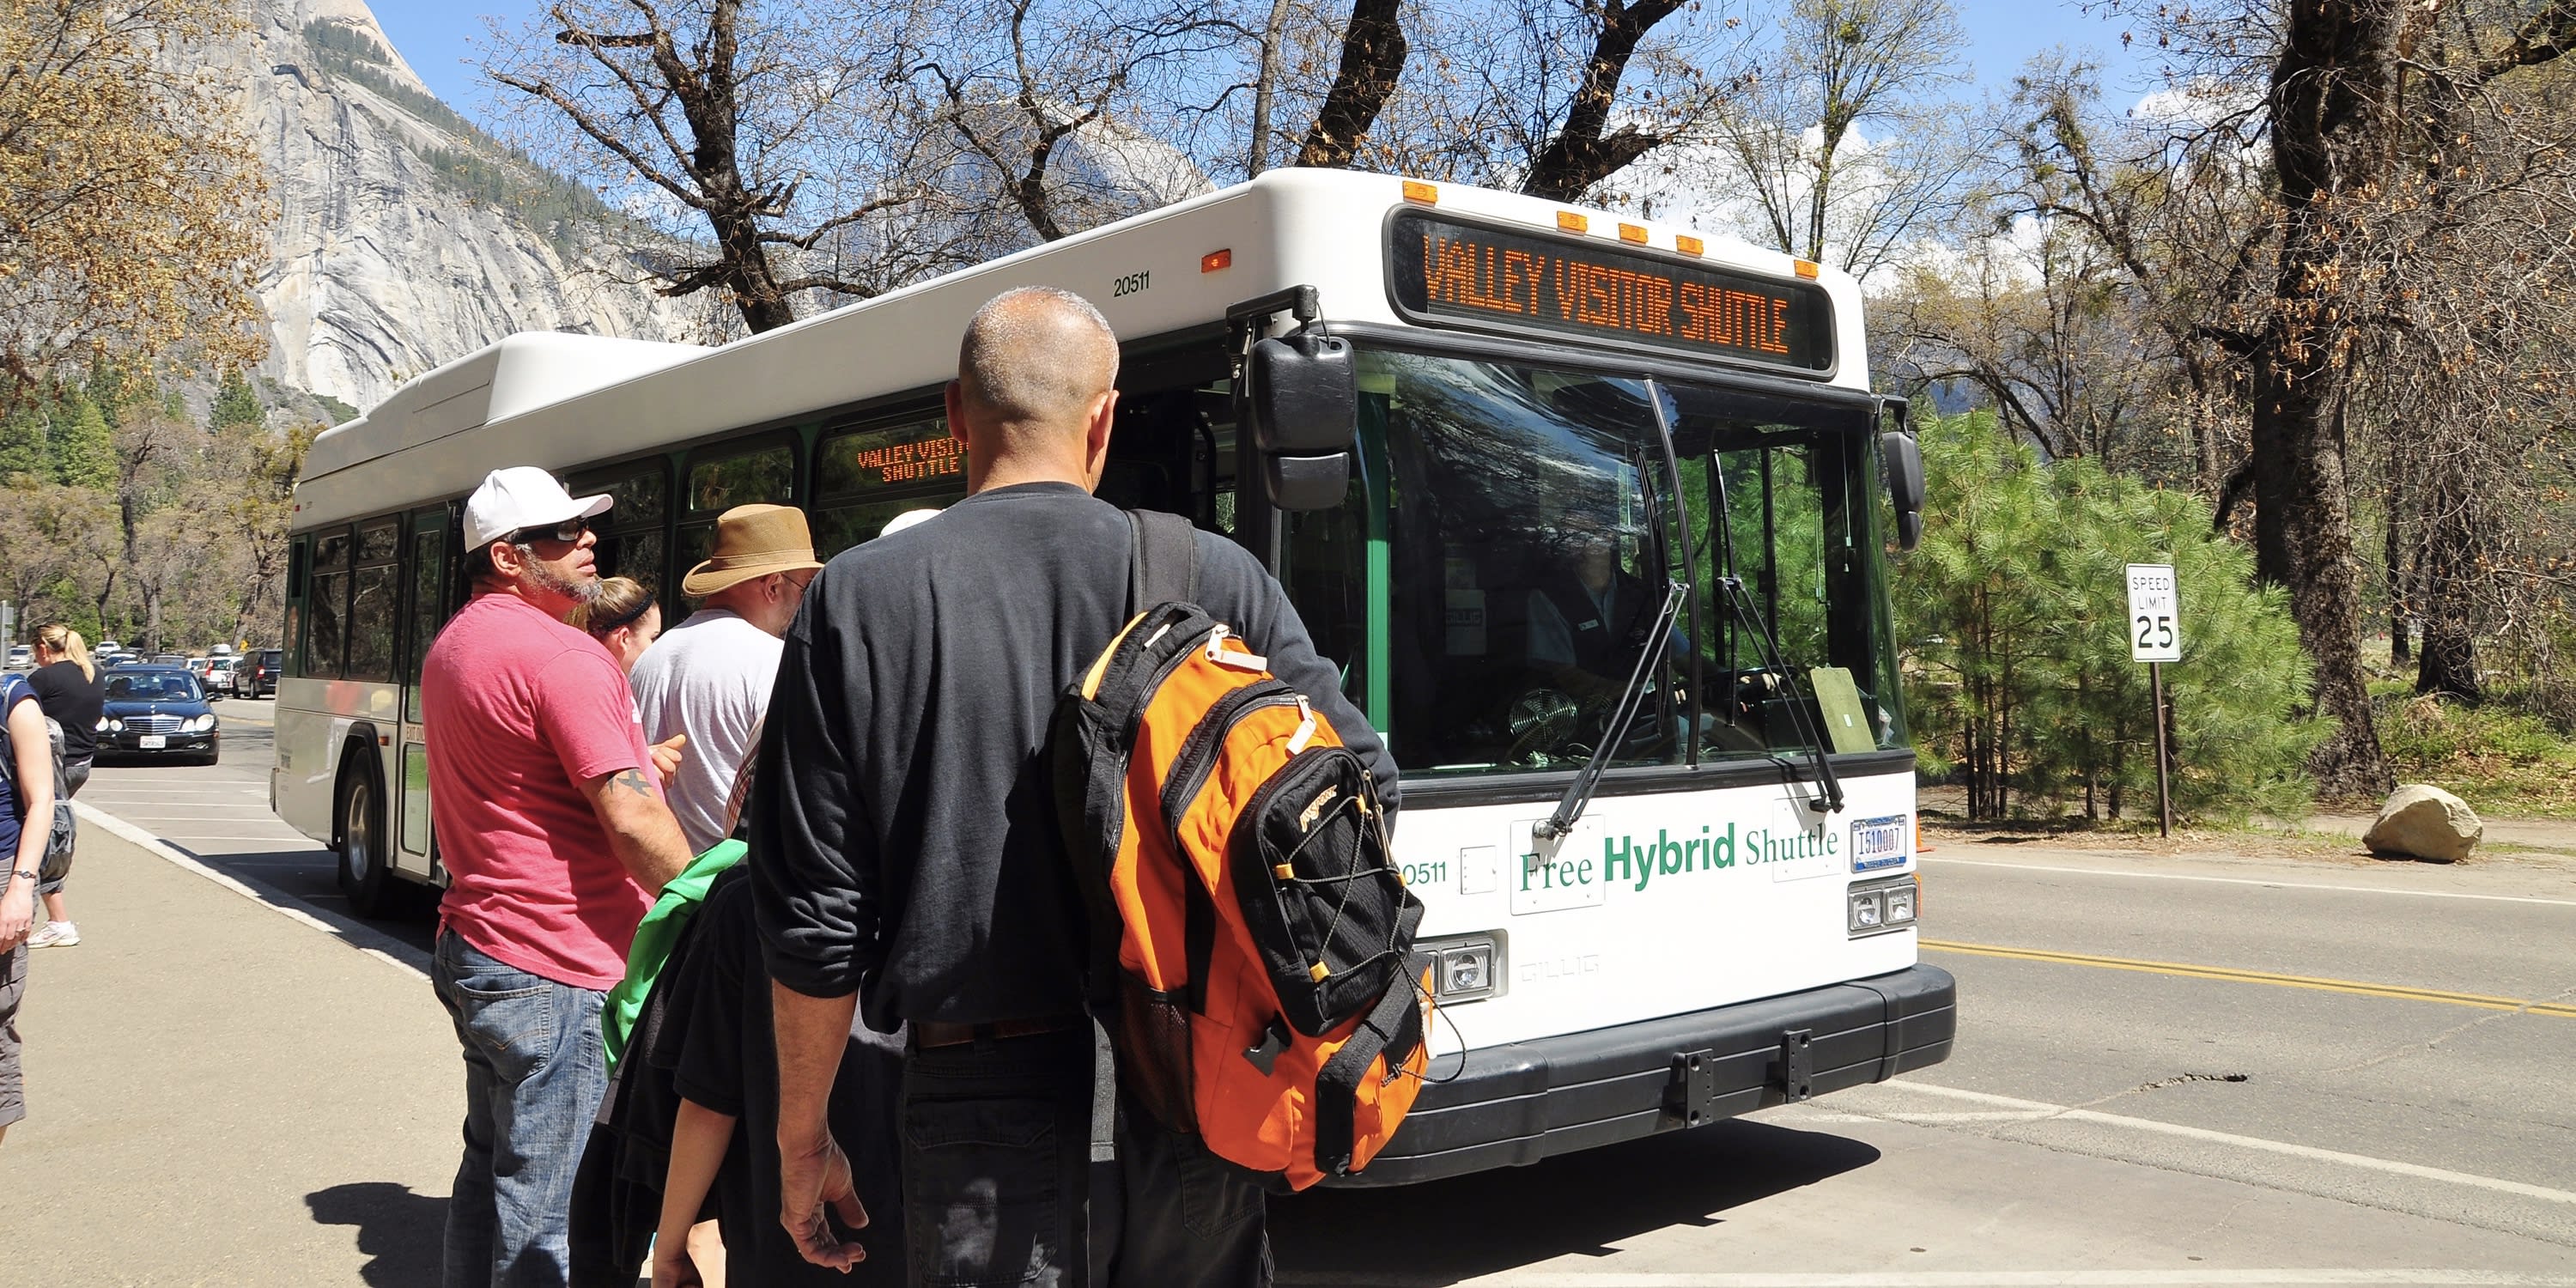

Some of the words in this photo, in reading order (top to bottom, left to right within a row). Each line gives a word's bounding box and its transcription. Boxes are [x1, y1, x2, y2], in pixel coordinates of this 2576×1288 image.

[1114, 270, 1150, 297] 20511
[1423, 234, 1546, 316] VALLEY
[1555, 258, 1672, 336] VISITOR
[1680, 282, 1789, 353] SHUTTLE
[858, 444, 913, 468] VALLEY
[917, 437, 969, 459] VISIT
[882, 456, 959, 482] SHUTTLE
[2132, 576, 2170, 591] SPEED
[2137, 597, 2167, 611] LIMIT
[2136, 615, 2173, 649] 25
[1519, 852, 1594, 892] Free
[1604, 822, 1736, 892] Hybrid
[1746, 823, 1838, 866] Shuttle
[1402, 861, 1446, 885] 0511
